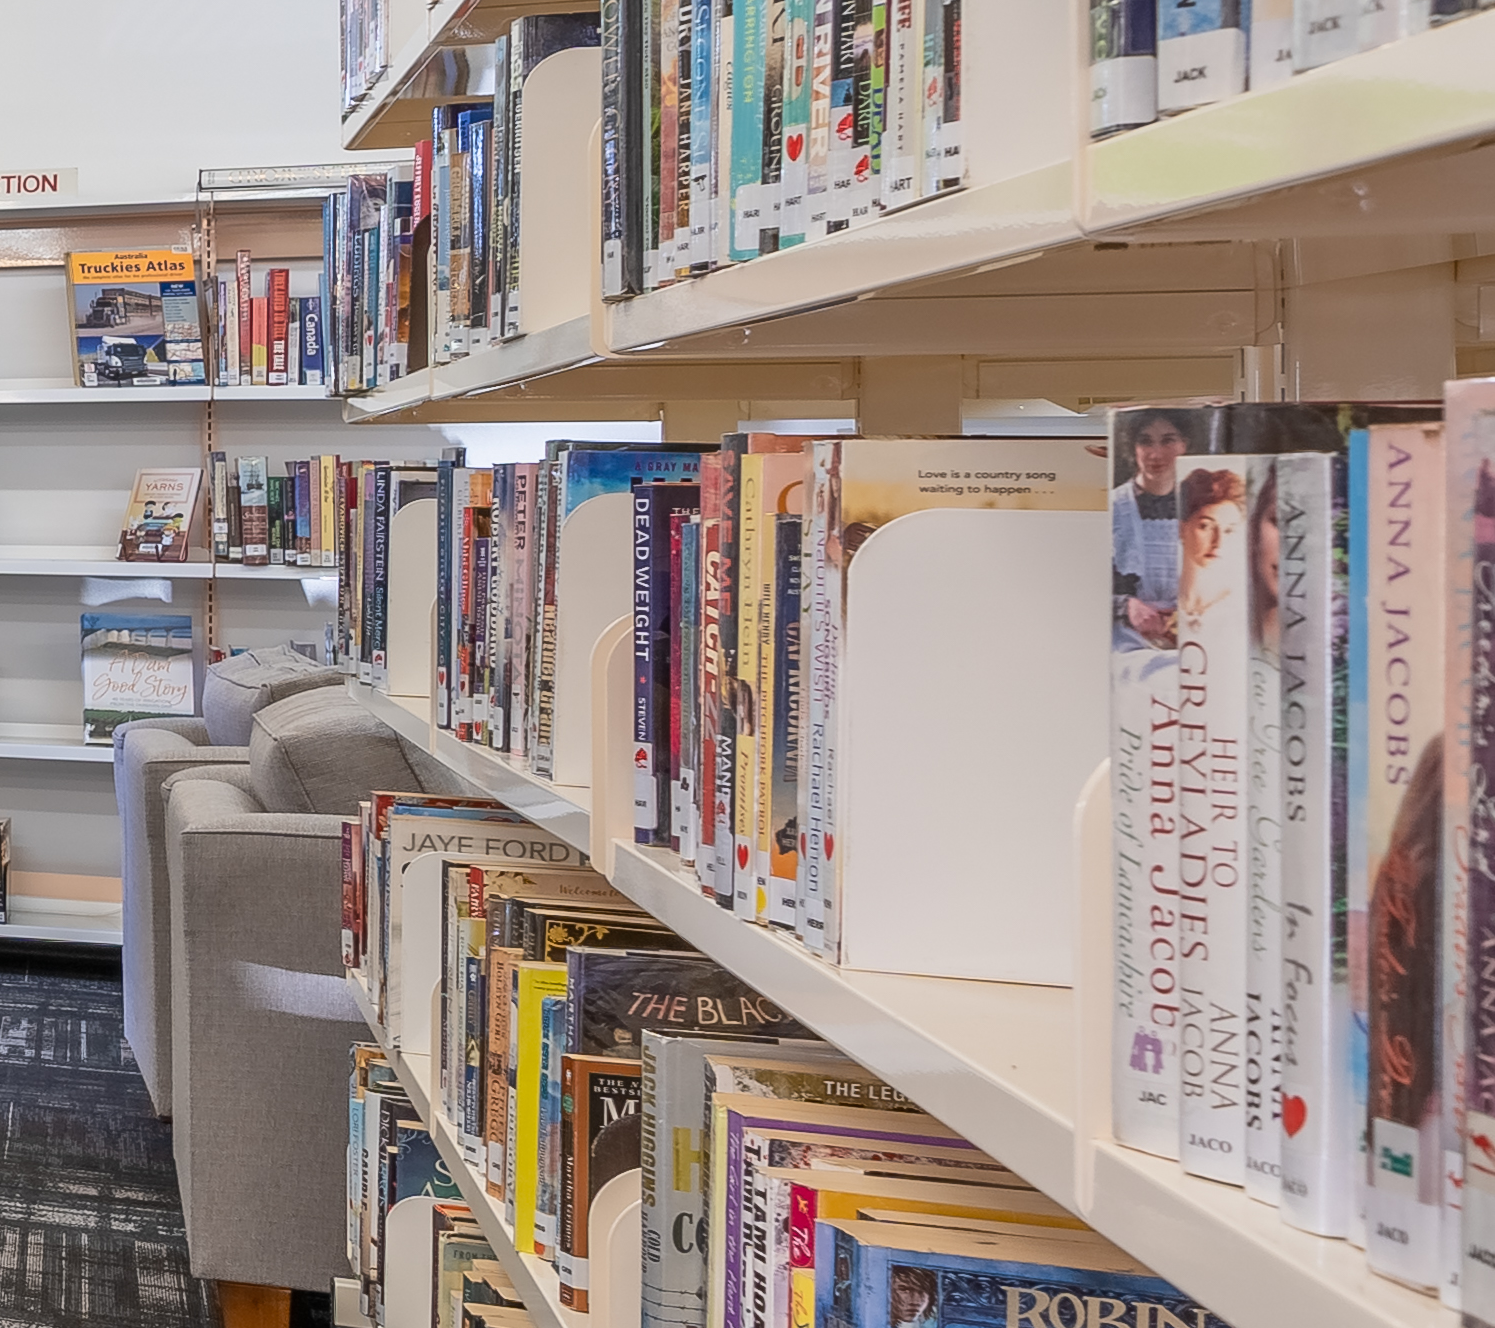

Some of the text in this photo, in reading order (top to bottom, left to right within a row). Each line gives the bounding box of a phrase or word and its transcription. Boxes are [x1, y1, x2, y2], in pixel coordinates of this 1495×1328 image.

[79, 260, 185, 274] Truckies Atlas
[306, 313, 318, 356] Canada
[146, 482, 184, 492] YARNS
[918, 469, 943, 480] Love
[970, 470, 1021, 483] country
[1025, 472, 1056, 483] song
[918, 483, 961, 496] waiting
[980, 485, 1030, 497] happen
[635, 498, 652, 662] DEAD WEIGHT
[1384, 441, 1413, 787] ANNA JACOBS
[402, 832, 570, 864] JAYE FORD
[1188, 1134, 1233, 1156] JACO
